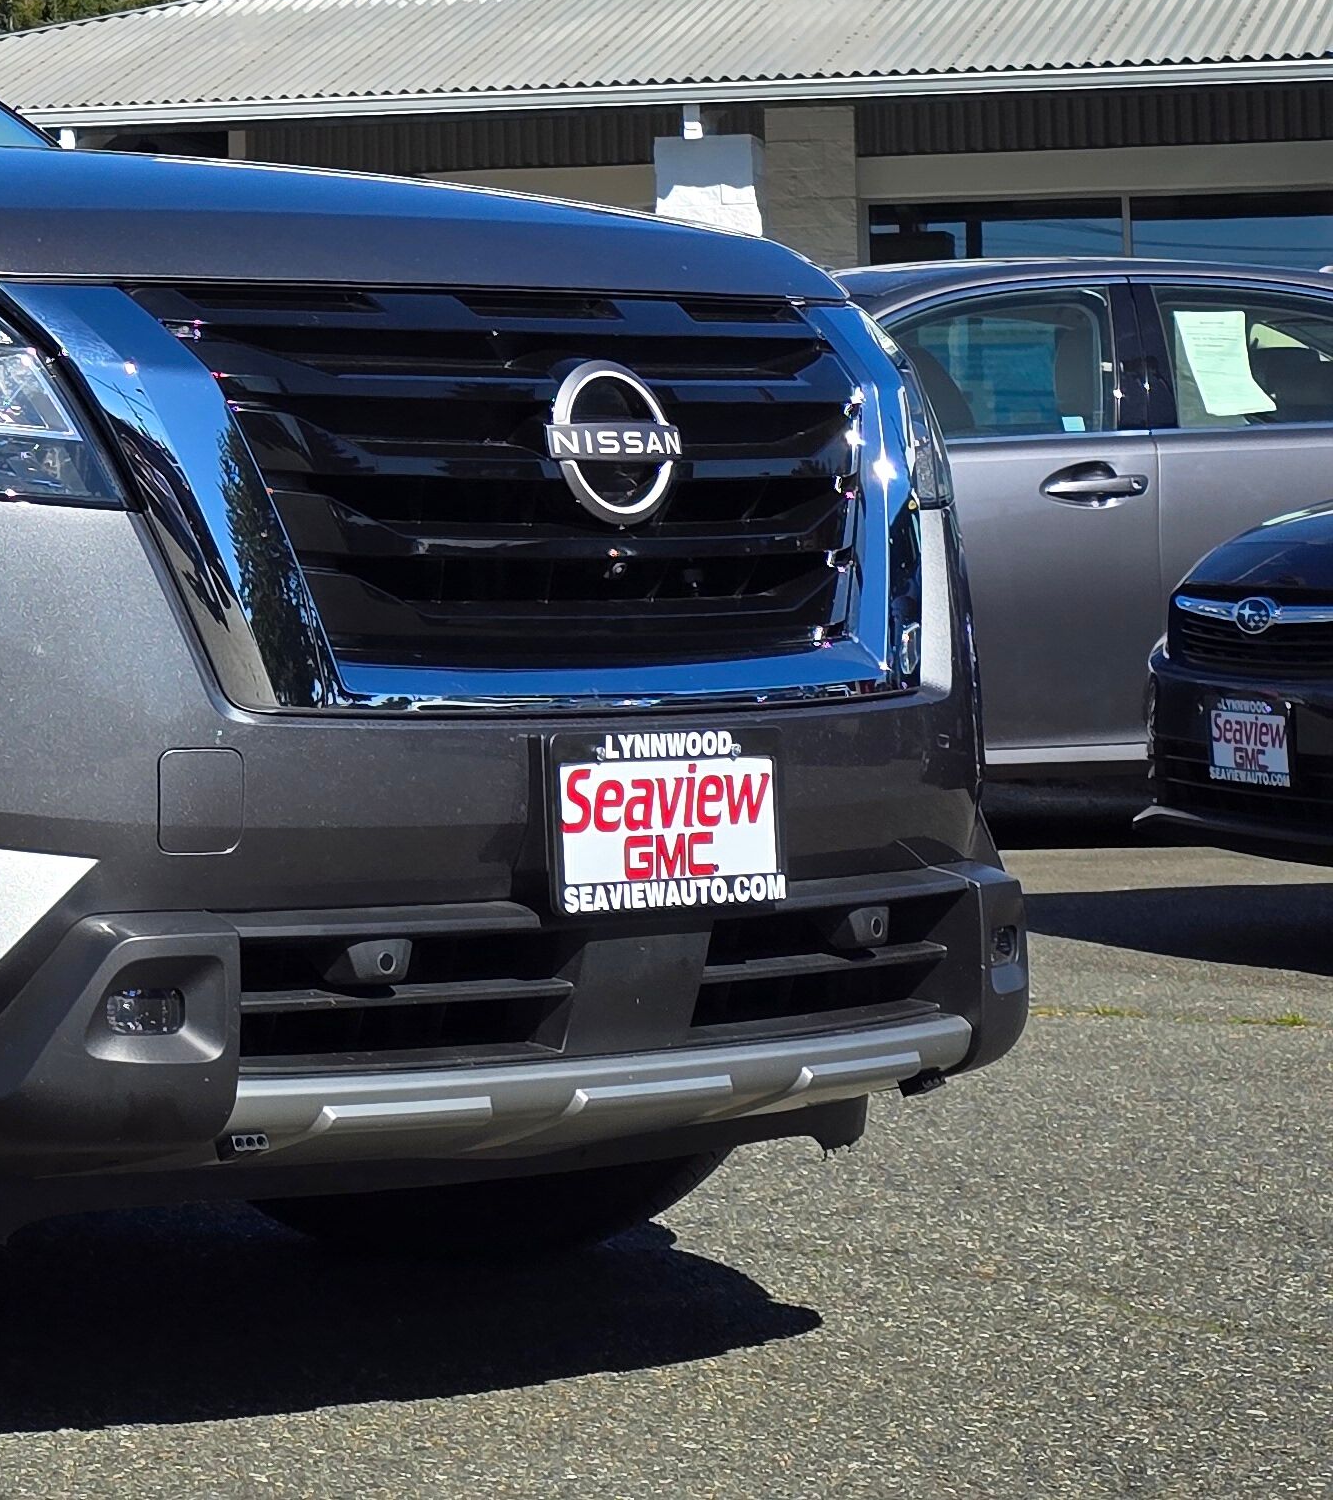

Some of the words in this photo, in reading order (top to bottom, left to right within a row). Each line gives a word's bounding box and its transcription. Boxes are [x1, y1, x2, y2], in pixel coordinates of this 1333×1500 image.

[552, 431, 682, 455] NISSAN
[605, 731, 733, 759] LYNNWOOD
[1213, 713, 1285, 749] Seaview
[1234, 746, 1269, 772] GMC
[1209, 766, 1290, 788] SEAVIEWAUTO.COM
[560, 763, 770, 833] Seaview
[624, 832, 715, 880] GMC
[564, 874, 786, 914] SEAVIEWAUTO.COM
